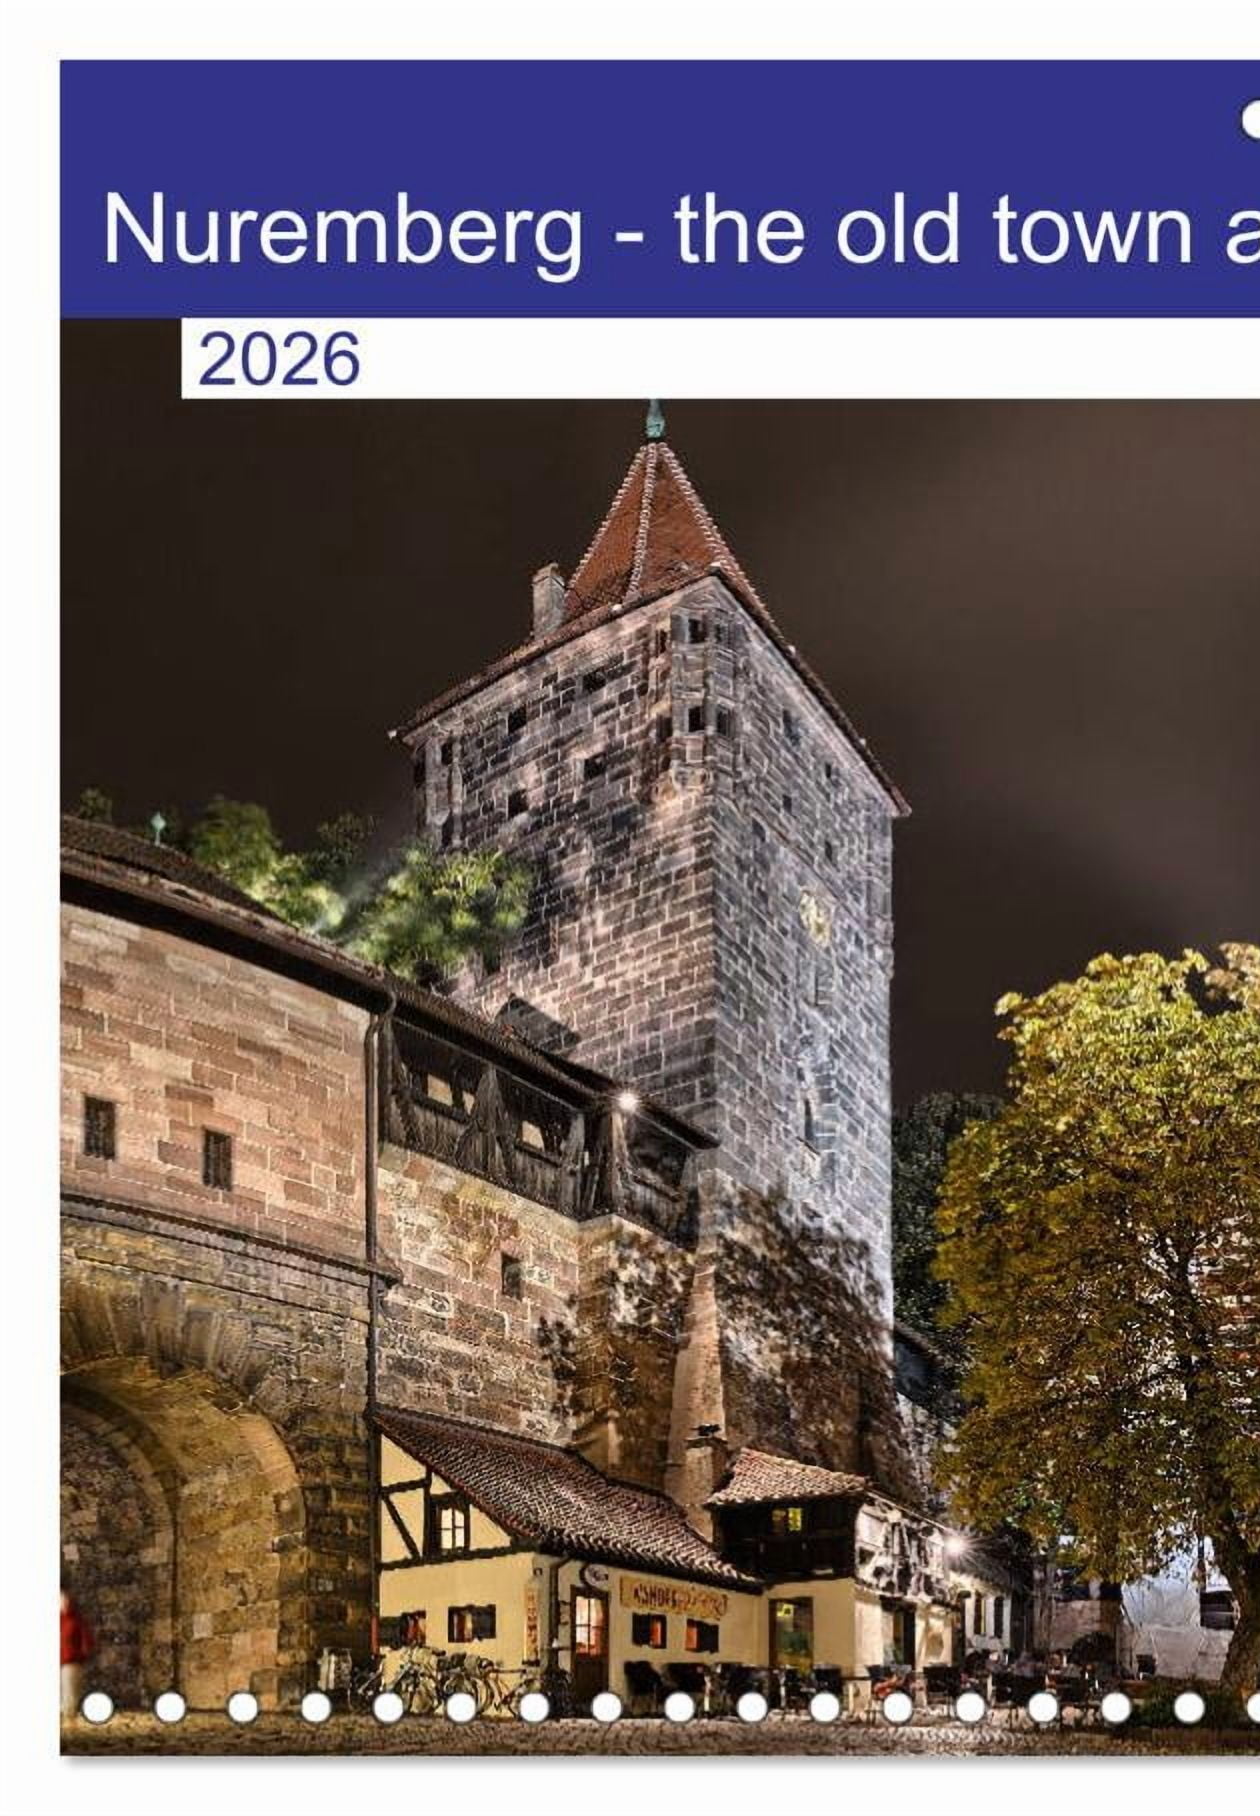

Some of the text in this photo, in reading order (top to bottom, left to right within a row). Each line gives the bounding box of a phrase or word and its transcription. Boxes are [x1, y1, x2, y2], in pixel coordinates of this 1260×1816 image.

[107, 191, 581, 283] Nuremberg
[615, 232, 644, 242] -
[673, 191, 805, 264] the
[837, 191, 959, 264] old
[992, 194, 1191, 264] town
[198, 330, 361, 387] 2026
